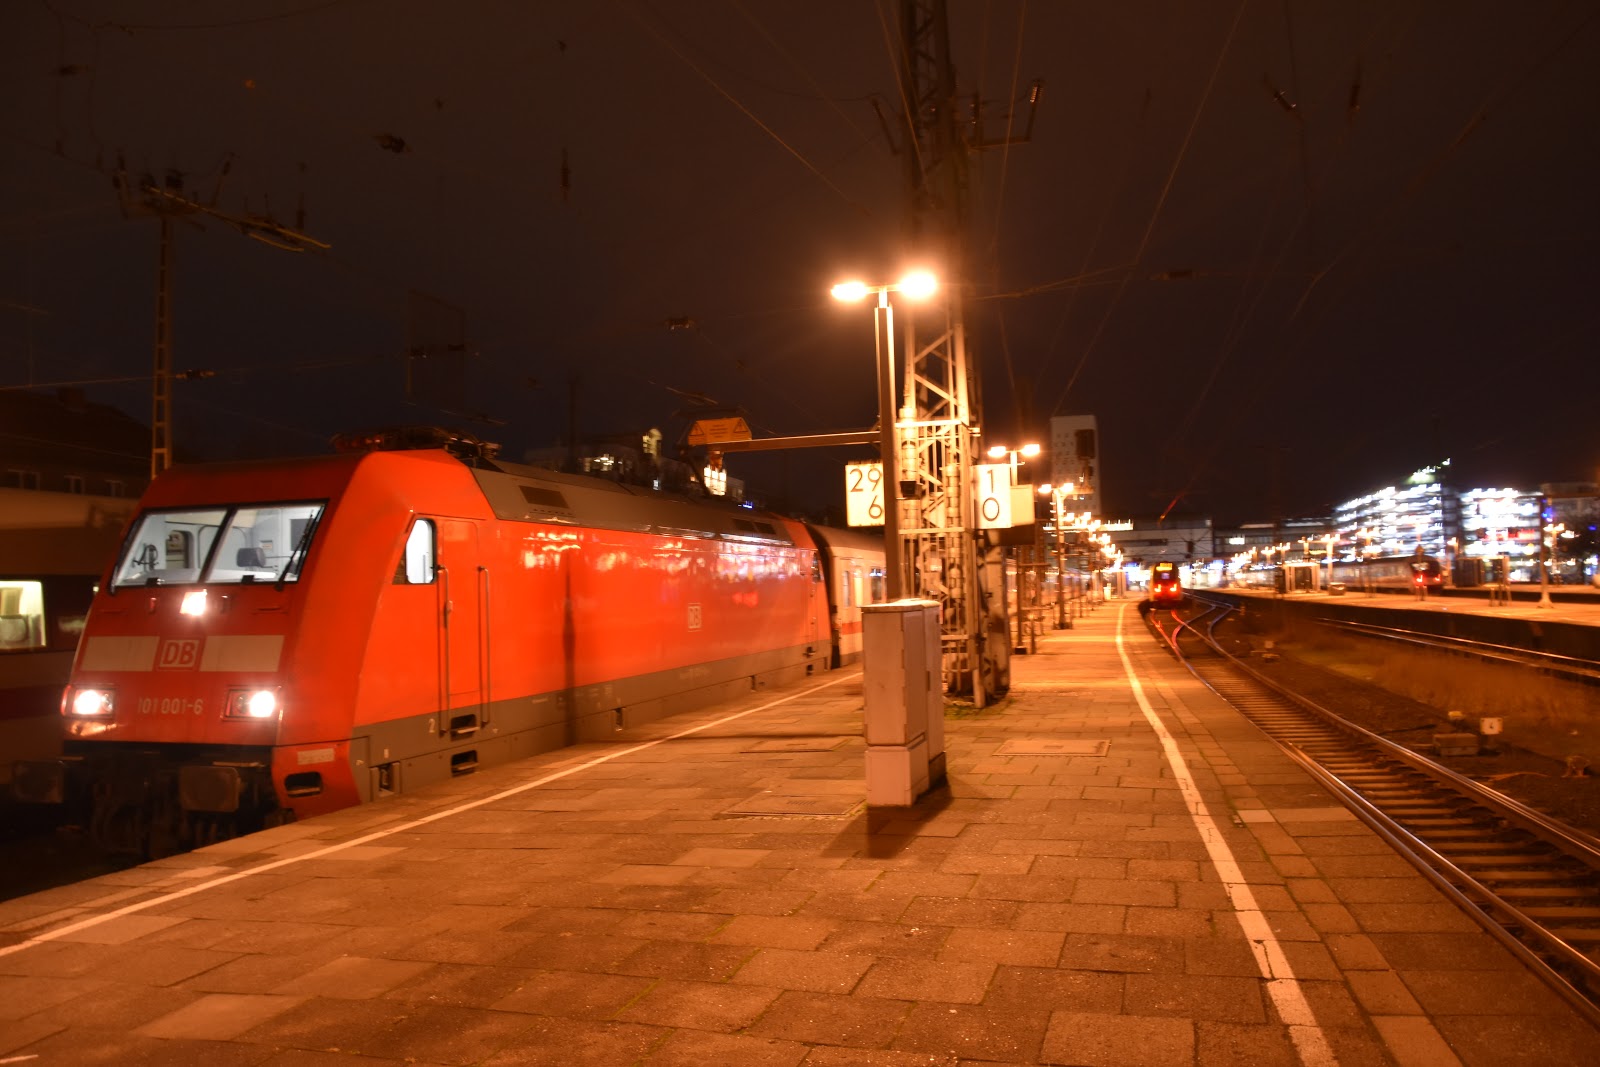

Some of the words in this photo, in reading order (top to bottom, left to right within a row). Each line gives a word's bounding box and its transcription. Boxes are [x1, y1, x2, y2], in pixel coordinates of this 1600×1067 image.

[849, 467, 883, 493] 29
[986, 469, 996, 494] 1
[868, 495, 883, 519] 6
[982, 497, 1000, 522] 0
[161, 640, 198, 666] DB
